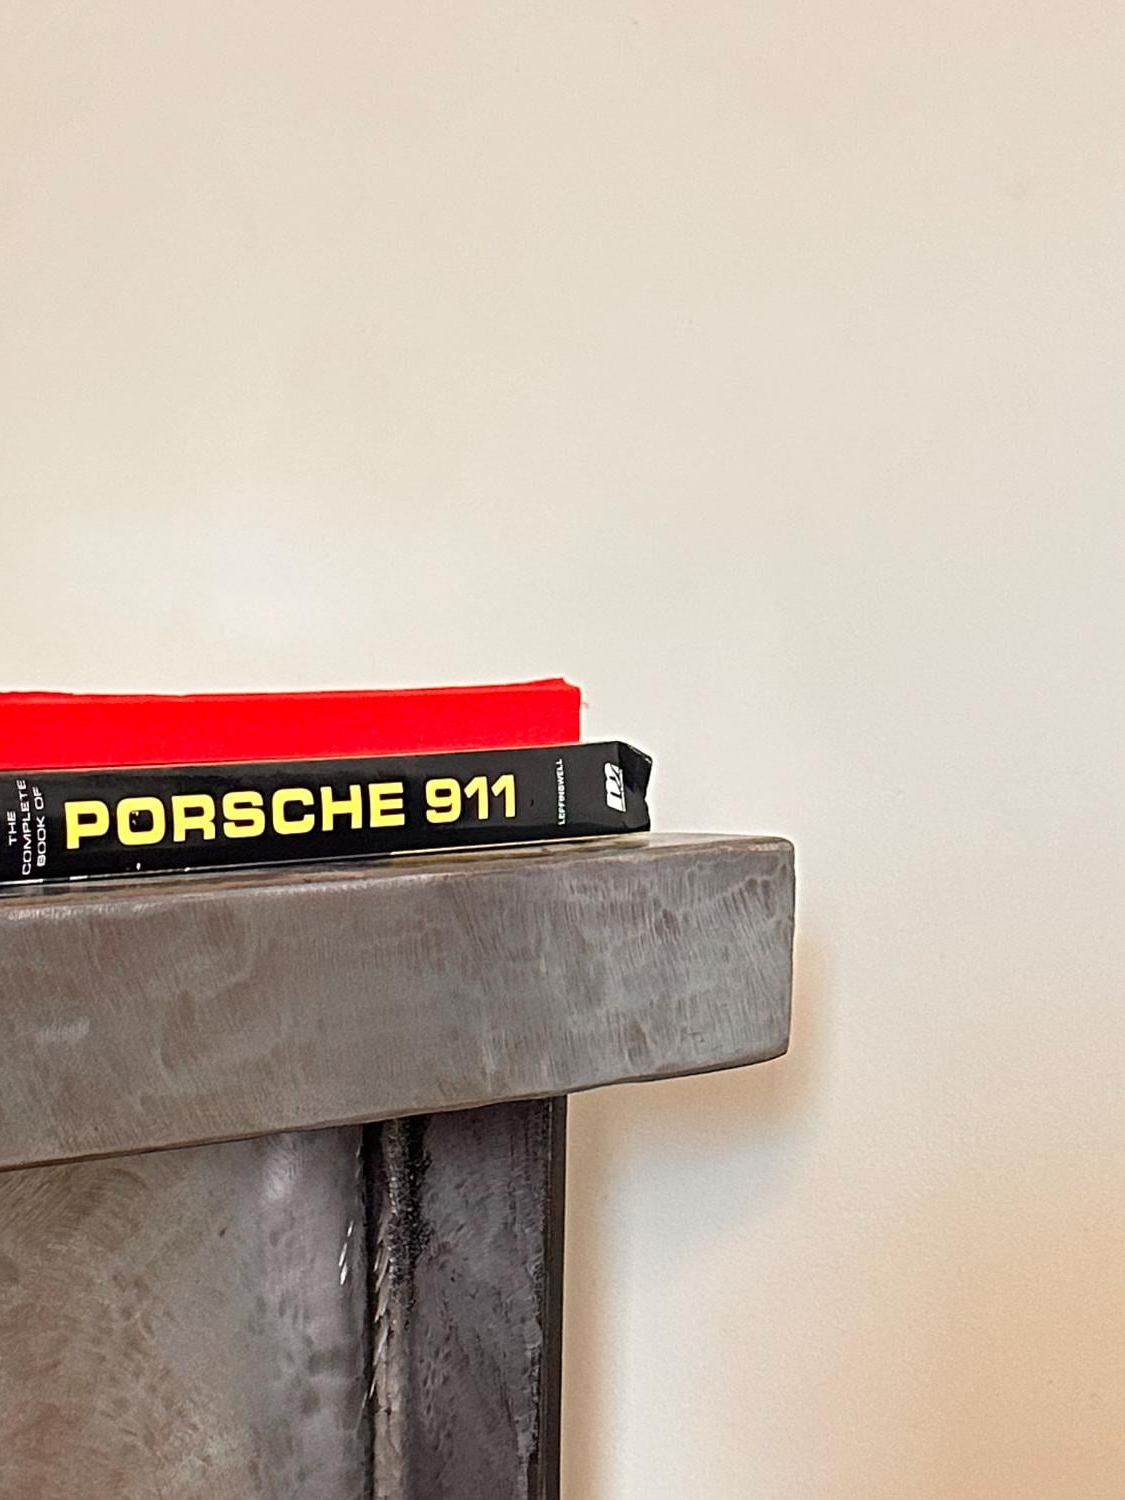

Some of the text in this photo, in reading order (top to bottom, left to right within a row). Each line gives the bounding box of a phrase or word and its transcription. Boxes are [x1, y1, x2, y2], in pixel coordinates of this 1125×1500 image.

[7, 811, 17, 846] THE
[16, 780, 32, 875] COMPLETE
[32, 786, 46, 867] BOOK OF
[64, 774, 516, 849] PORSCHE 911
